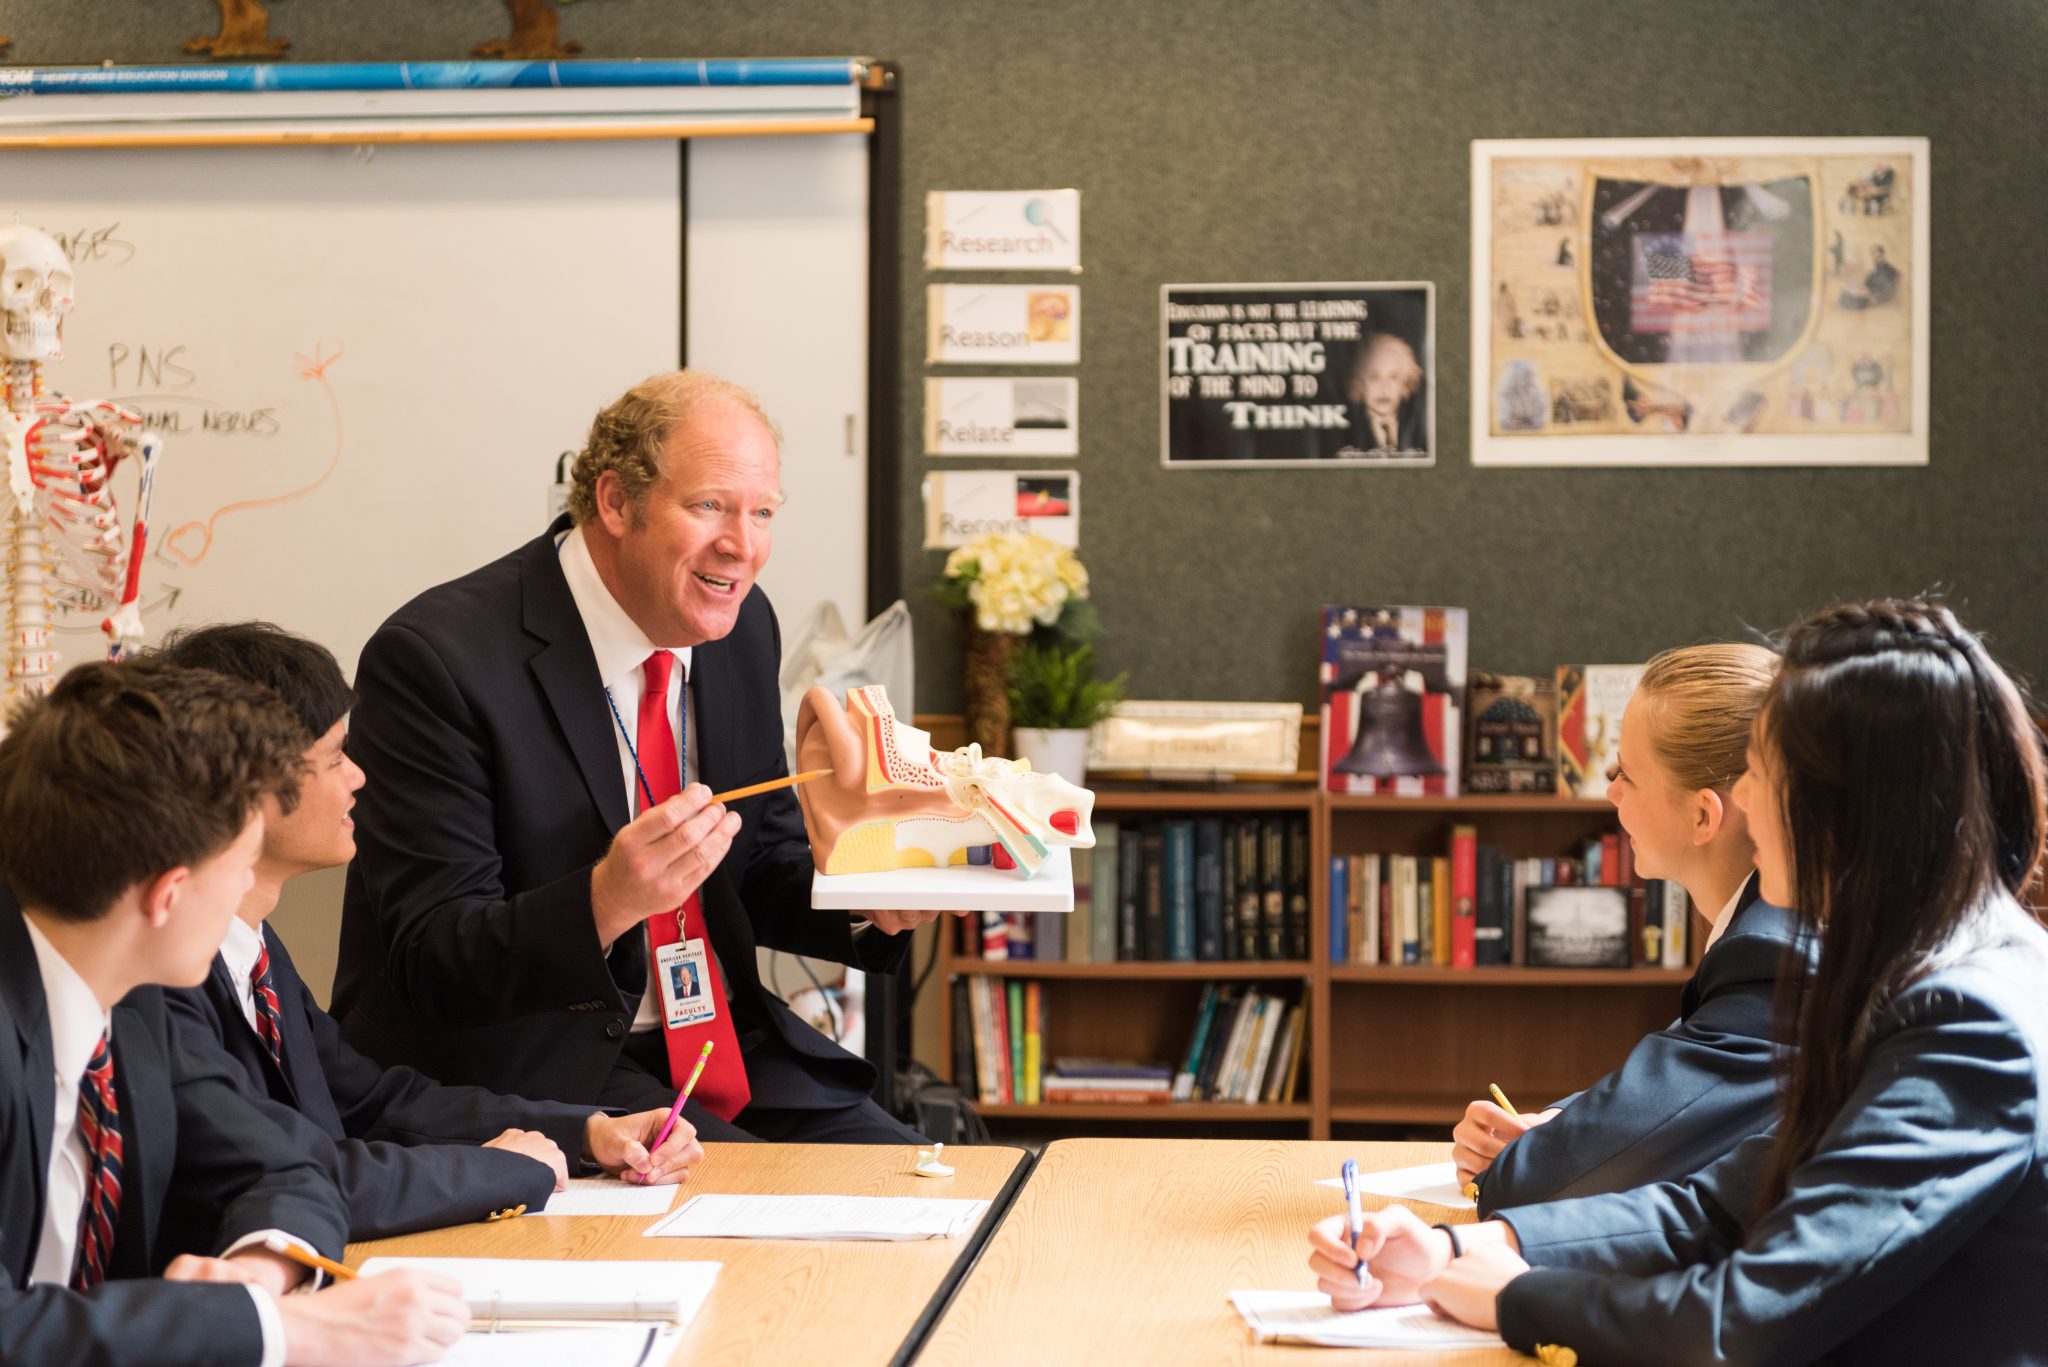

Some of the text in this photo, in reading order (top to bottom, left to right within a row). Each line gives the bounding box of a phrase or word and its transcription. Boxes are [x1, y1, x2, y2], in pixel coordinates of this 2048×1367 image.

[80, 72, 114, 82] JONES
[117, 71, 178, 81] EDUCATION
[180, 70, 229, 80] DIVISION
[940, 230, 1052, 253] Research
[1169, 300, 1368, 321] EDUCATION IS NOT THE LEARNING
[940, 325, 1029, 348] Reason
[1187, 321, 1362, 342] OF FACTS BUT THE
[108, 342, 196, 389] PNS
[1168, 336, 1327, 375] TRAINING
[1169, 375, 1319, 398] OF THE MIND TO
[1223, 401, 1351, 430] THINK
[937, 421, 1014, 443] Relate
[675, 1005, 706, 1016] FACULTY
